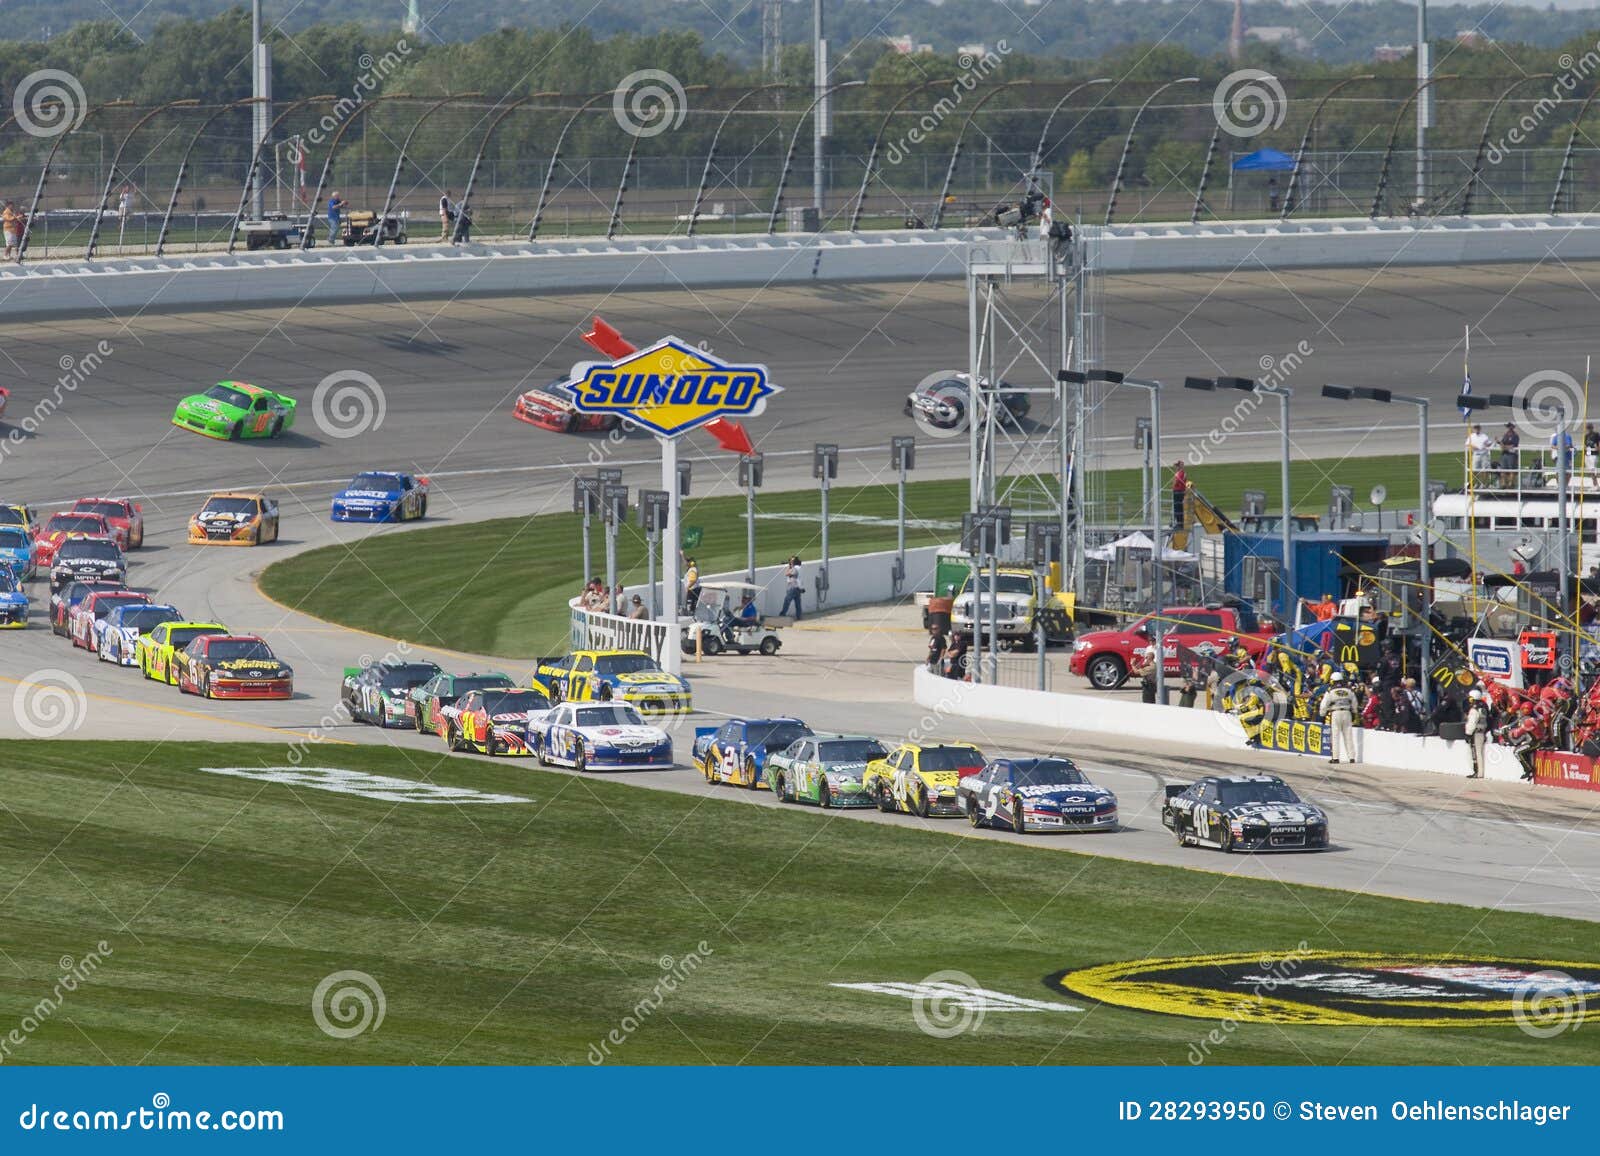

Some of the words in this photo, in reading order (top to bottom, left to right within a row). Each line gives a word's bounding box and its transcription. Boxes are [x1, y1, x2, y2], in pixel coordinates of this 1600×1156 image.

[584, 373, 755, 405] SUNOCO
[199, 511, 251, 522] CAT
[571, 676, 586, 700] 17
